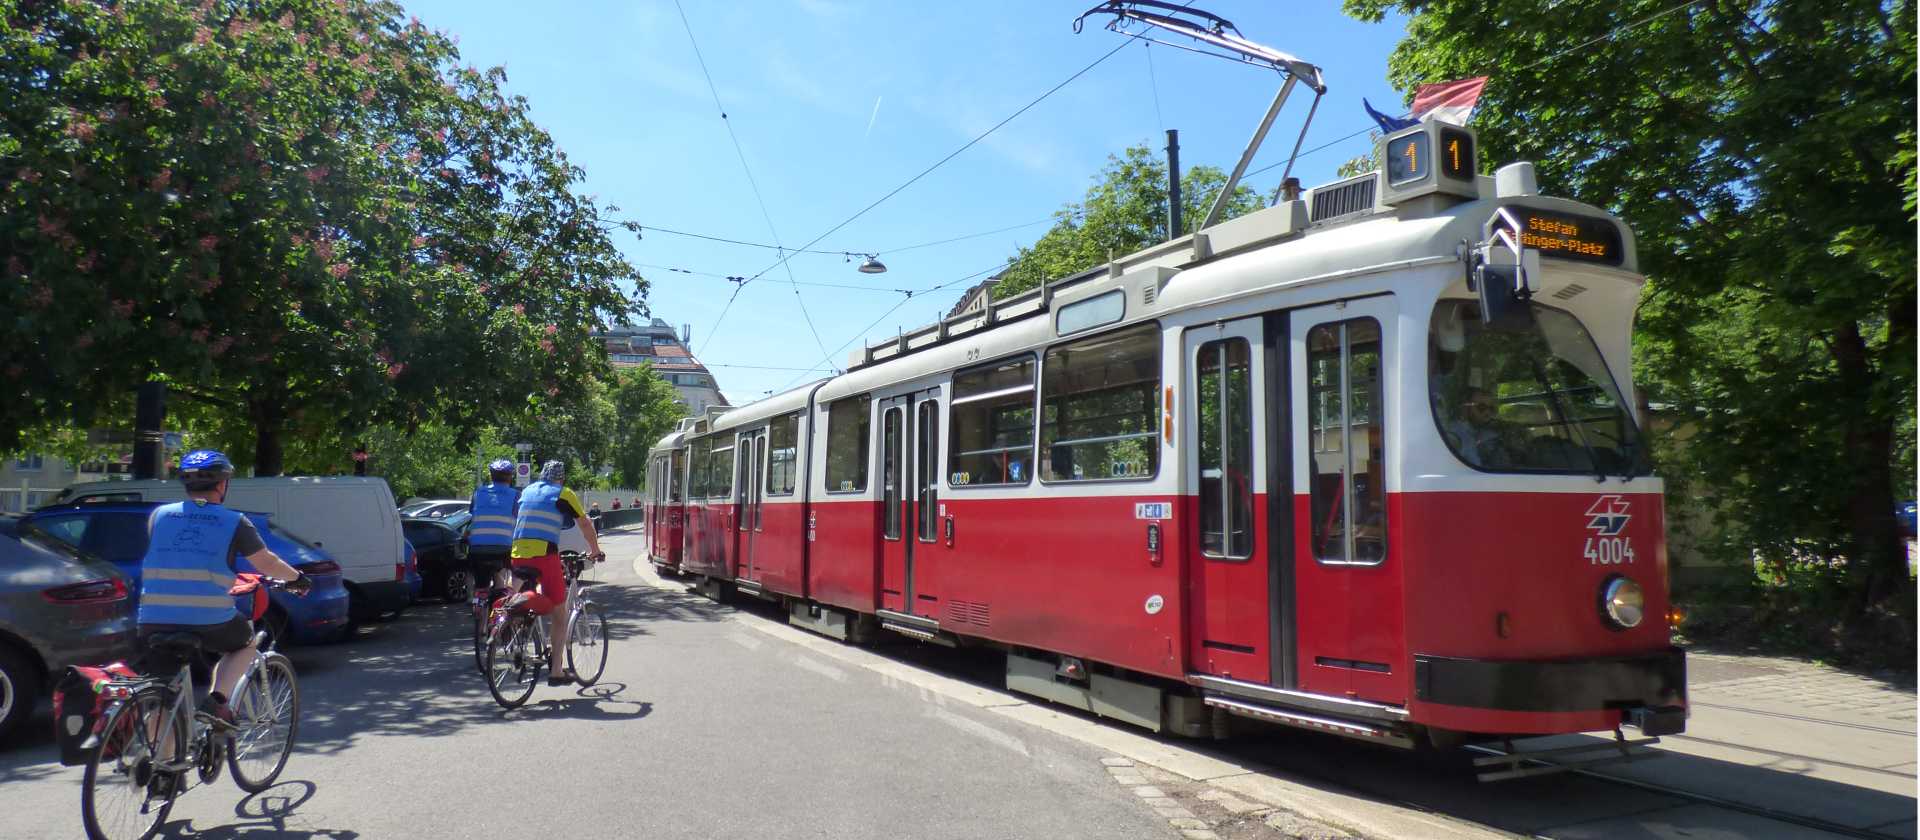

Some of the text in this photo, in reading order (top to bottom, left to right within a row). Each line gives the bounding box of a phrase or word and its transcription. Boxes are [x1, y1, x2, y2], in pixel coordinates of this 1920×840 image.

[1404, 142, 1417, 172] 1
[1449, 139, 1460, 171] 1
[1529, 216, 1577, 236] Stefan
[1584, 537, 1634, 565] 4004
